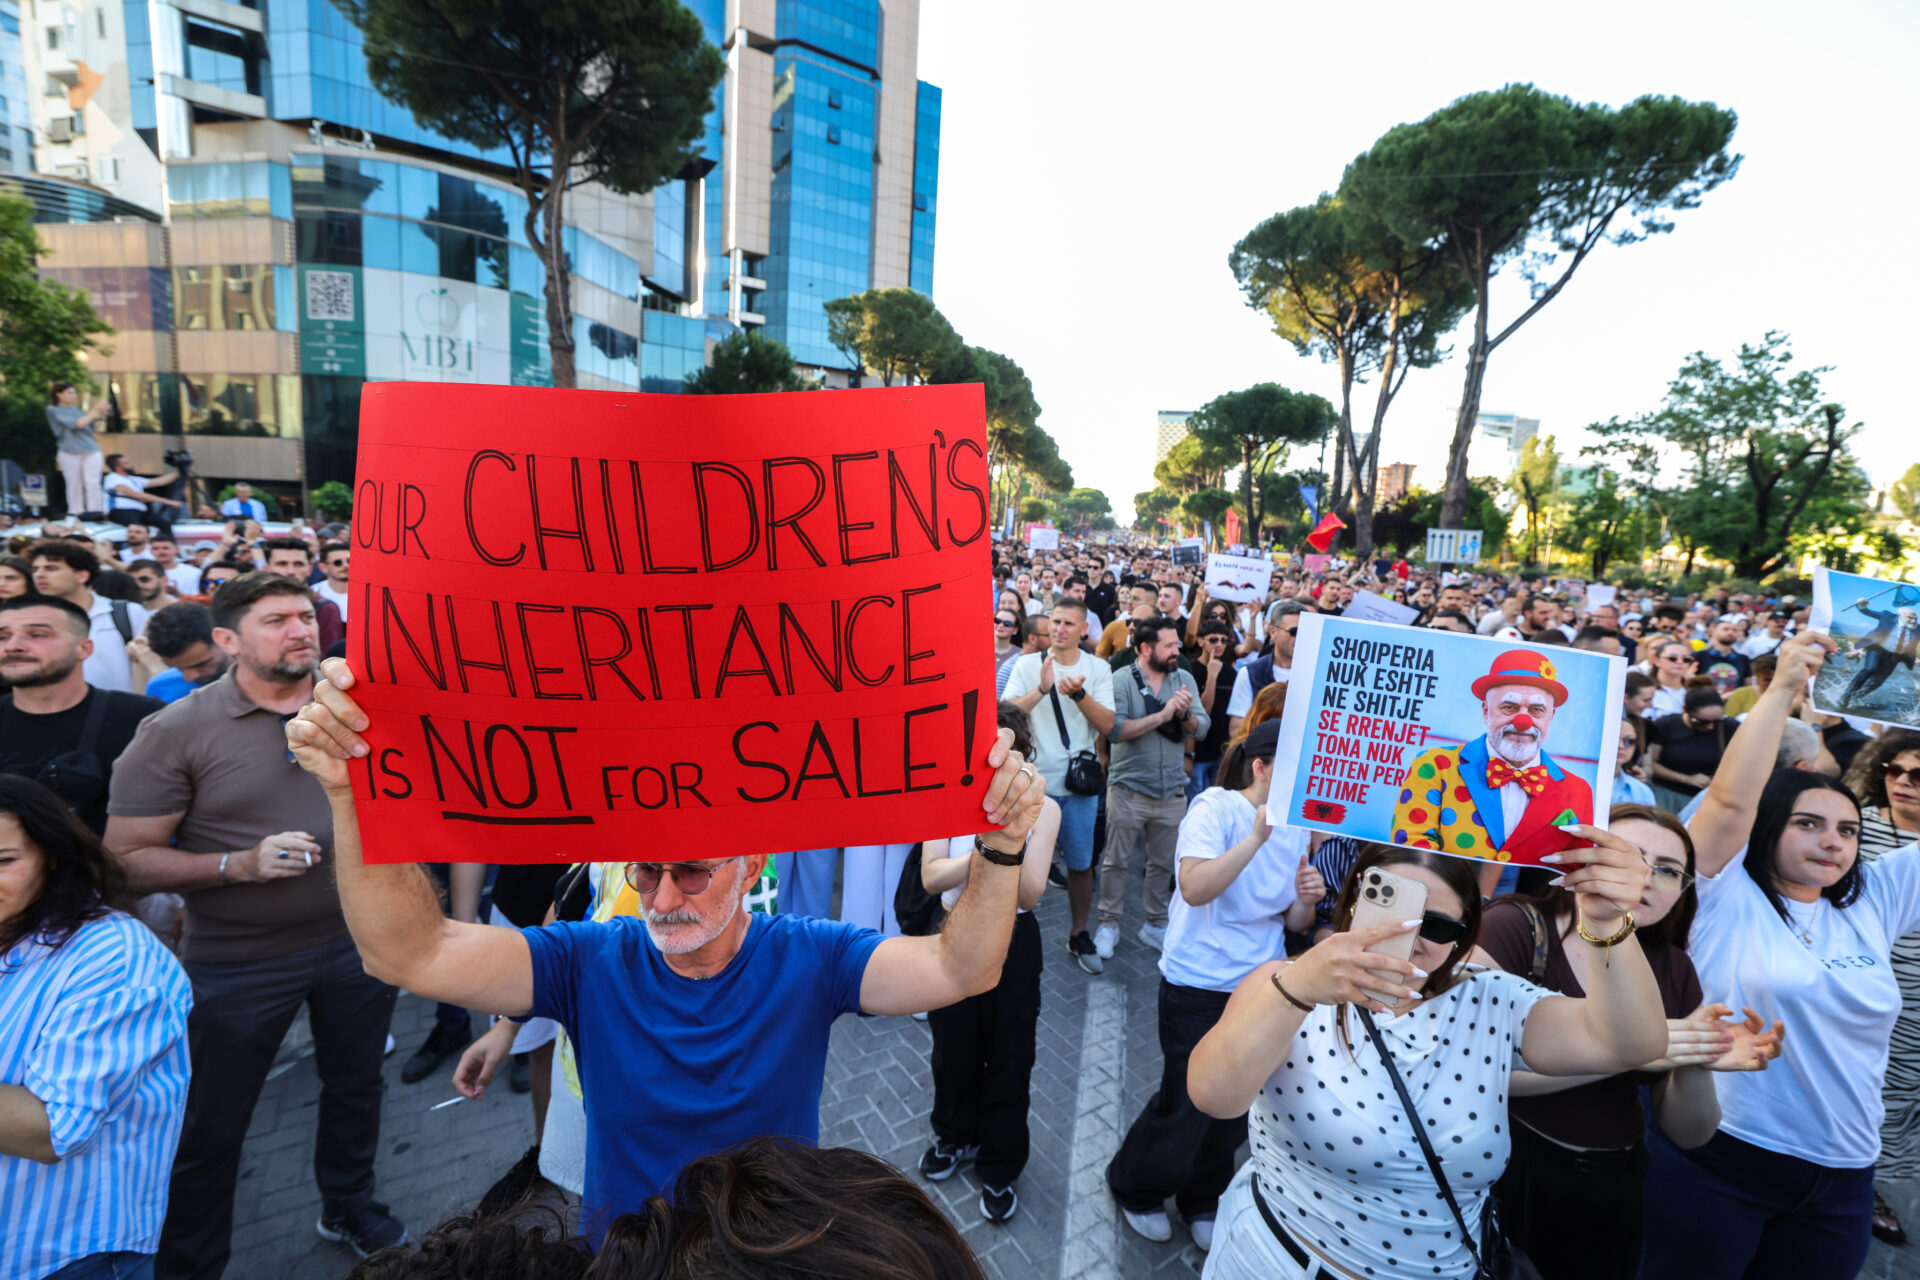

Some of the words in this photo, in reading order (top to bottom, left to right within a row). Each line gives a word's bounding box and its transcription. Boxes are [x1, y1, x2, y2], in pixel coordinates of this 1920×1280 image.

[355, 479, 430, 560] OUR
[463, 429, 987, 574] CHILDREN'S
[363, 583, 946, 701] INHERITANCE
[1331, 636, 1434, 672] SHQIPERIA
[1326, 661, 1368, 687] NUK
[1373, 668, 1439, 698] ESHTE
[1322, 685, 1349, 709] NE
[1353, 690, 1424, 721] SHITJE
[1318, 709, 1342, 732] SE
[1345, 714, 1431, 747] RRENJET
[366, 747, 412, 800] IS
[419, 713, 579, 811] NOT
[602, 762, 712, 811] FOR
[732, 689, 980, 804] SALE!
[1316, 732, 1360, 759] TONA
[1366, 741, 1405, 766] NUK
[1310, 754, 1370, 781] PRITEN
[1373, 765, 1406, 787] PER
[1305, 775, 1371, 804] FITIME
